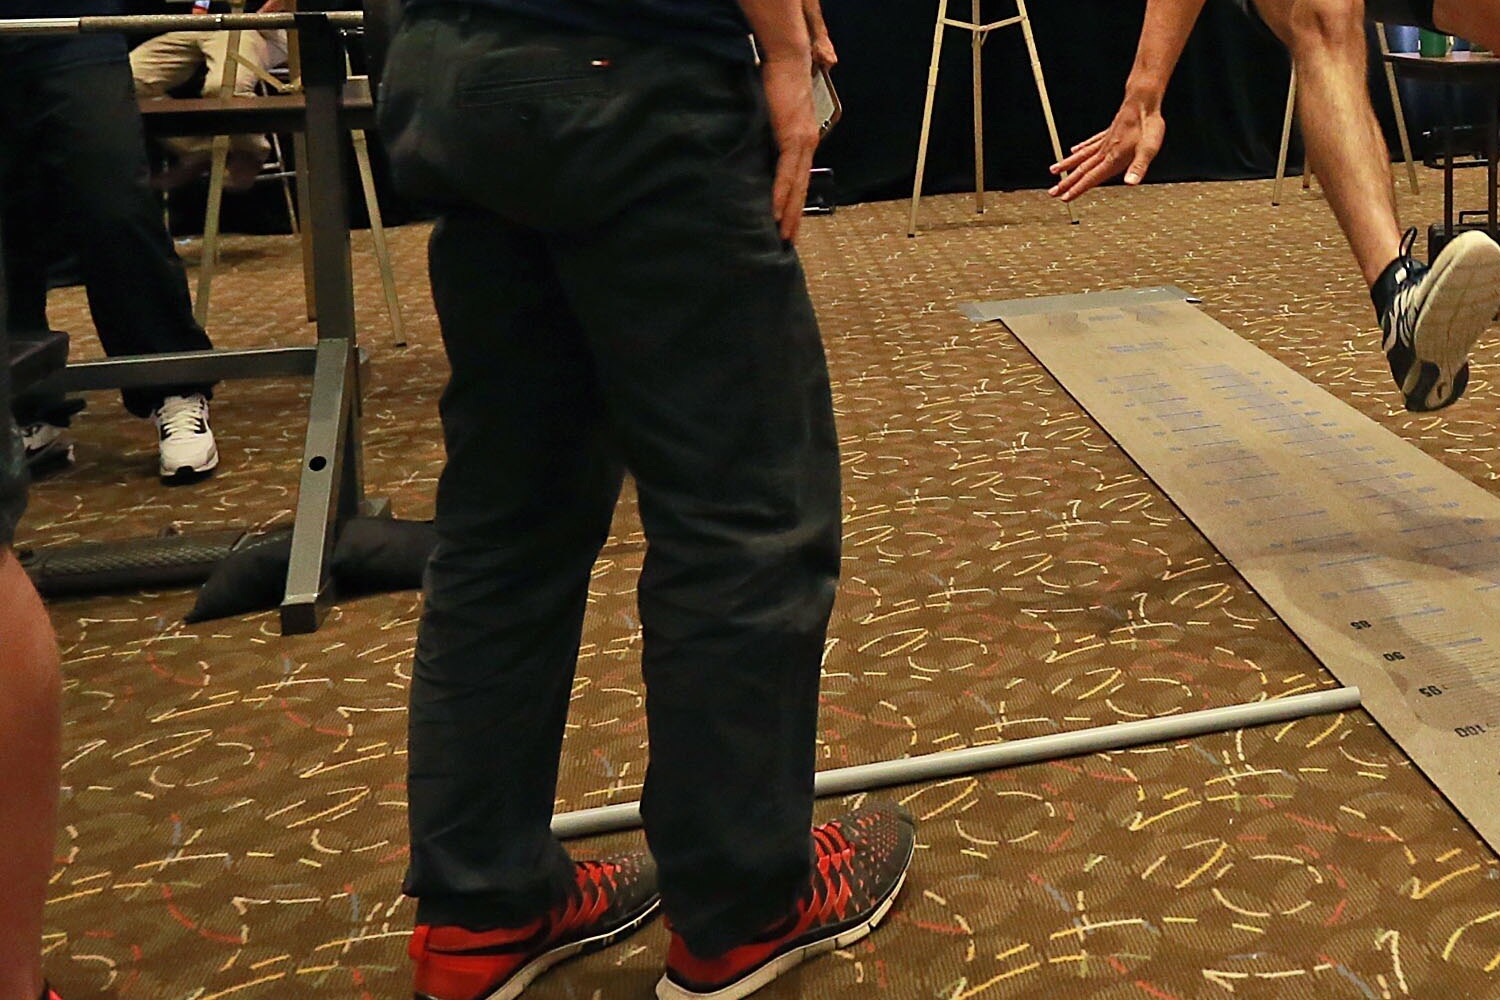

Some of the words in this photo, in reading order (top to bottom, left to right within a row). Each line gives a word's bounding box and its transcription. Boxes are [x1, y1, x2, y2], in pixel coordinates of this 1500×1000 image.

[1383, 651, 1405, 662] 90
[1419, 684, 1443, 698] 95
[1455, 724, 1486, 739] 100
